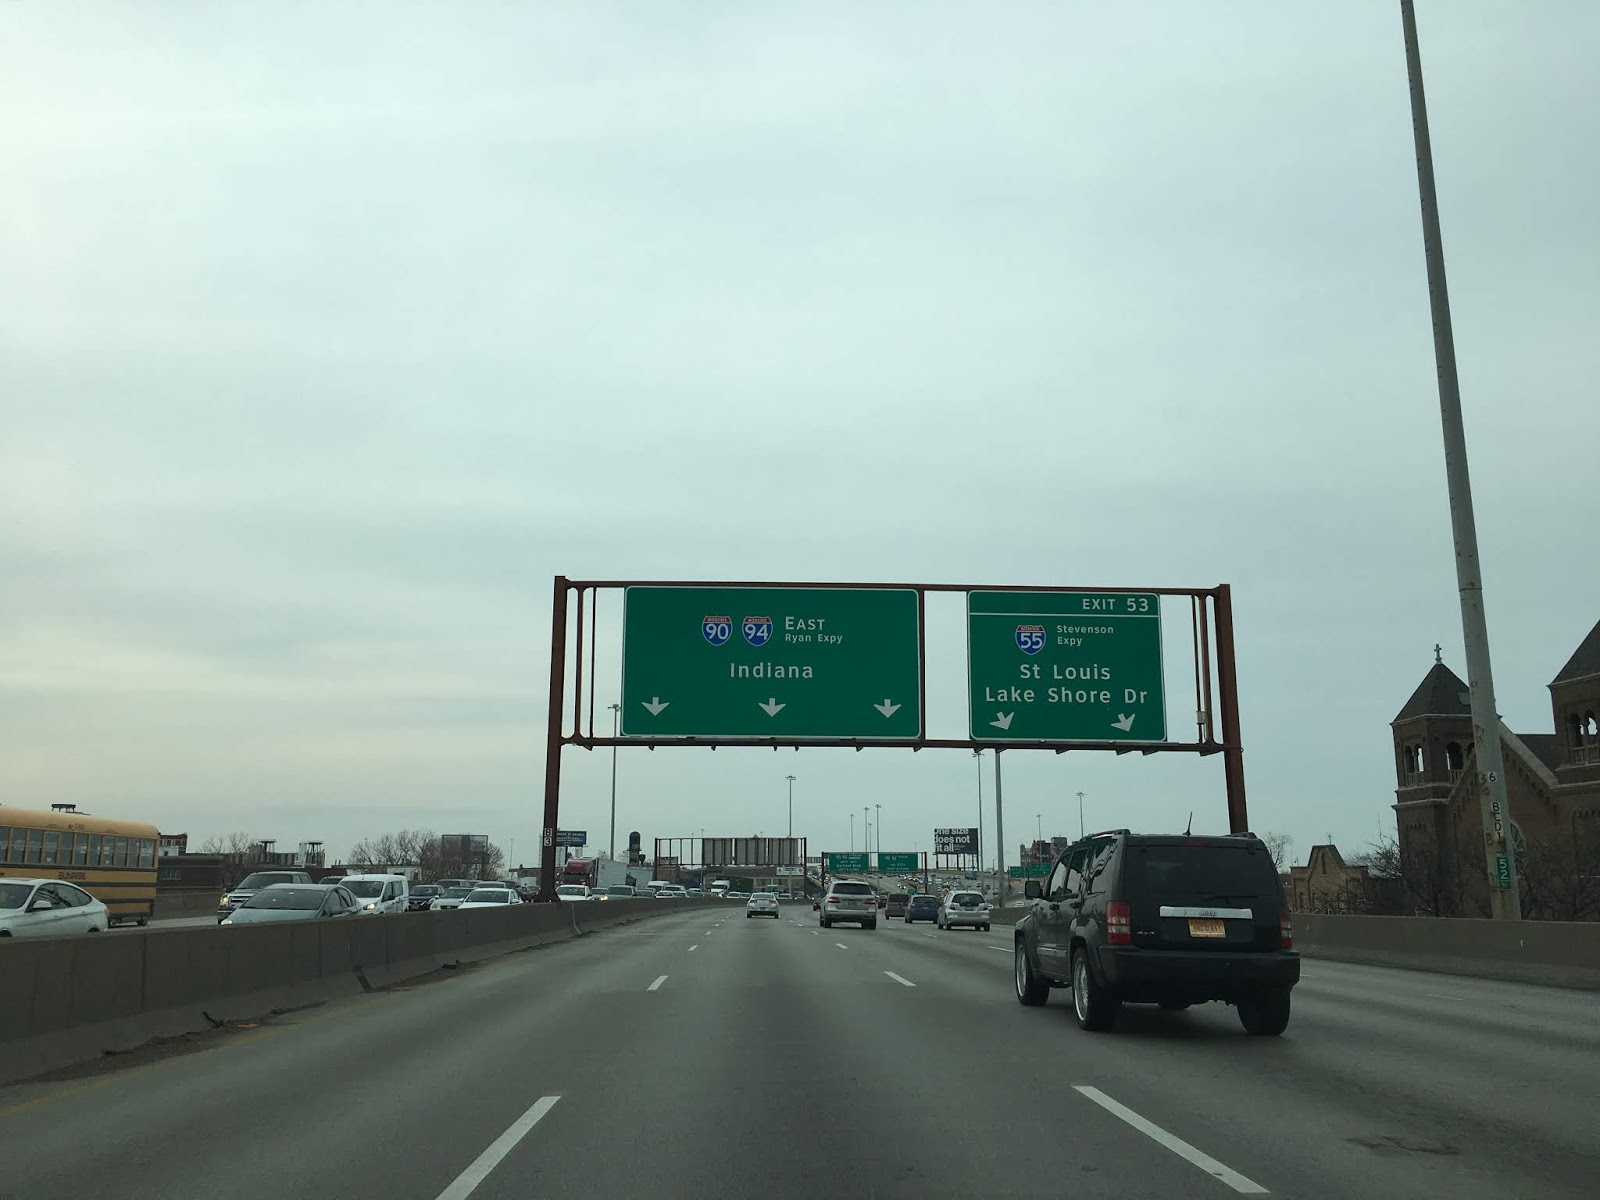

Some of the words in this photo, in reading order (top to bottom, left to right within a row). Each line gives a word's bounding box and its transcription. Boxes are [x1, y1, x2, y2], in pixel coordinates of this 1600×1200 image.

[1082, 598, 1116, 610] EXIT
[1127, 598, 1149, 612] 53
[785, 616, 825, 630] EAST
[1056, 625, 1114, 635] Stevenson
[705, 623, 729, 640] 90
[745, 624, 769, 640] 94
[785, 634, 812, 645] Ryan
[817, 634, 844, 645] Expy
[1020, 632, 1043, 649] 55
[1057, 636, 1083, 647] Expy
[730, 662, 813, 679] Indiana
[1020, 664, 1041, 679] St
[1053, 664, 1111, 680] Louis
[985, 686, 1035, 702] Lake
[1047, 686, 1111, 703] Shore
[1124, 688, 1148, 703] Dr
[1489, 772, 1497, 781] 6
[955, 835, 971, 844] not
[944, 843, 954, 852] all
